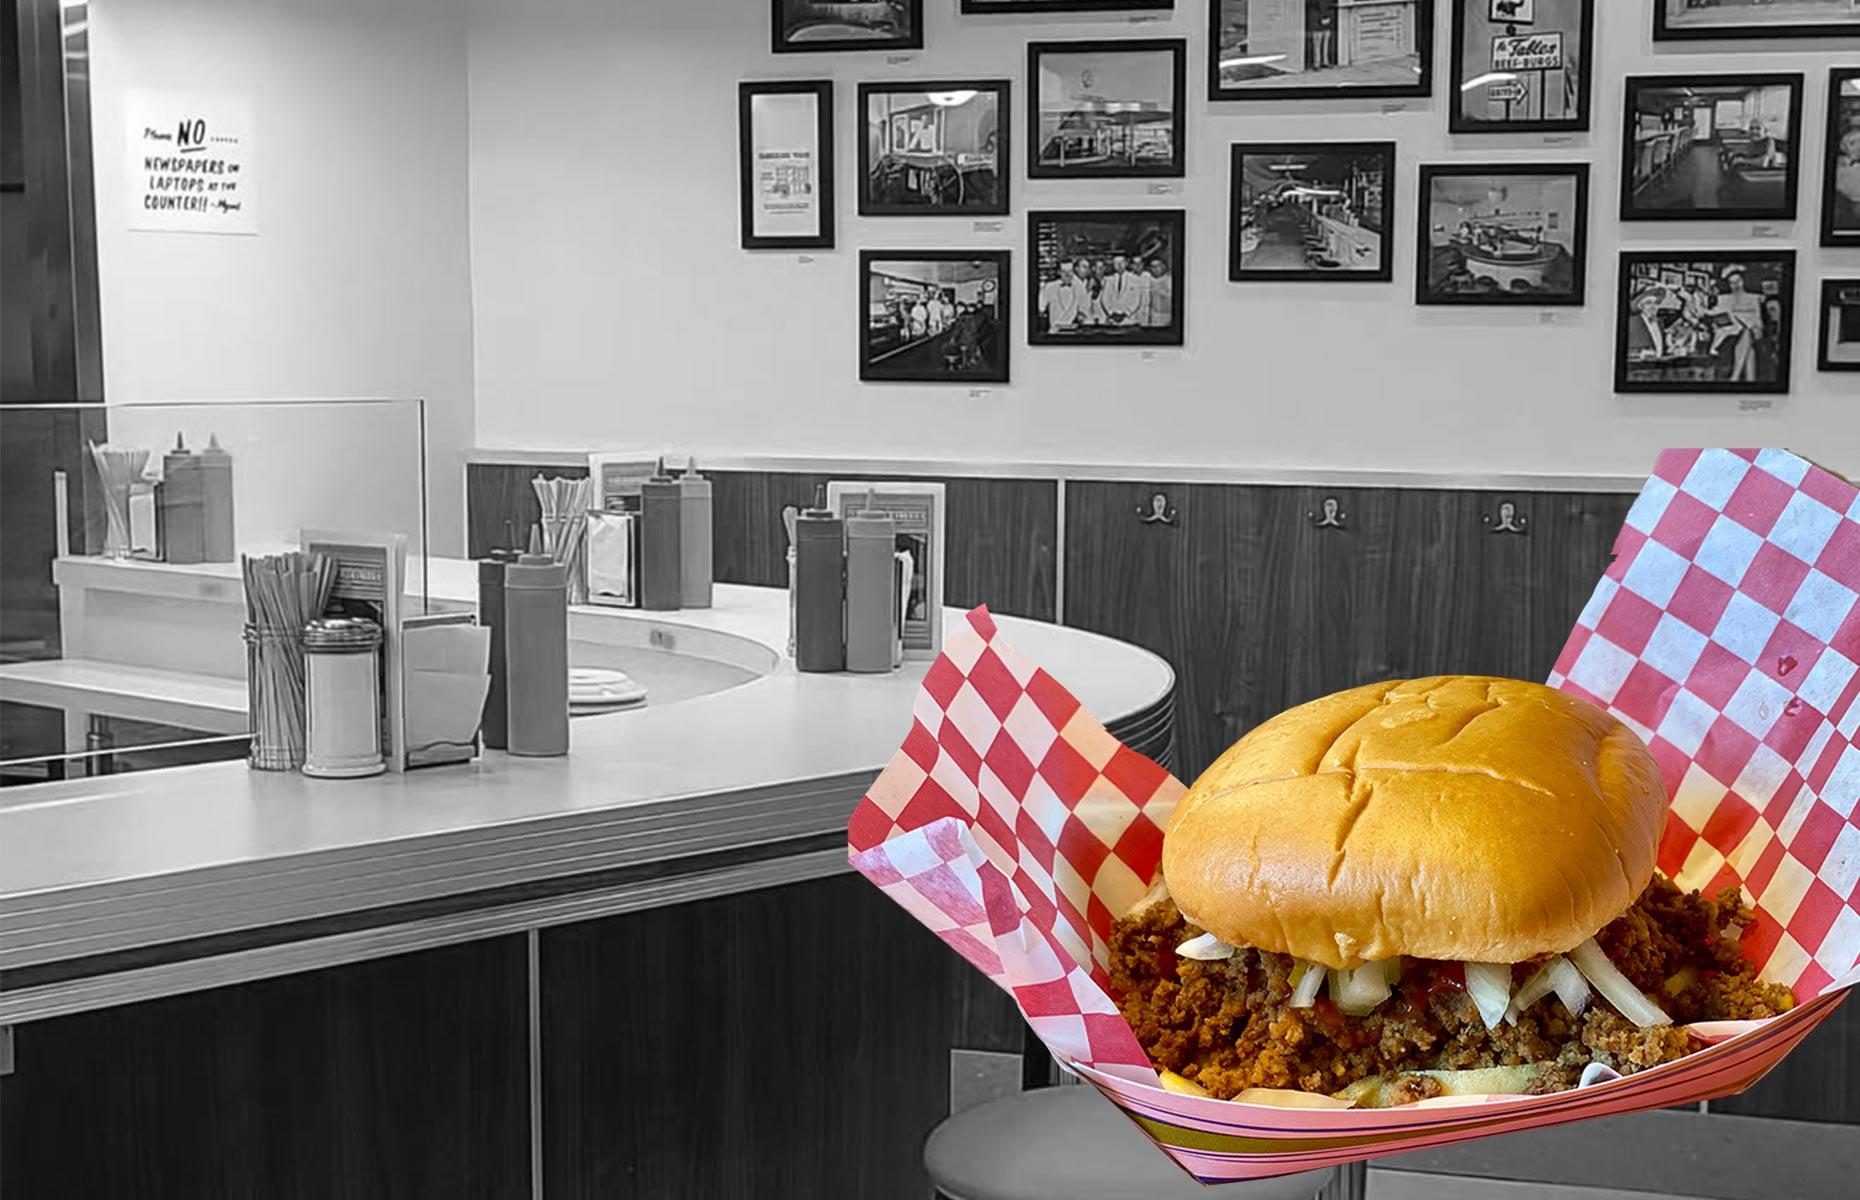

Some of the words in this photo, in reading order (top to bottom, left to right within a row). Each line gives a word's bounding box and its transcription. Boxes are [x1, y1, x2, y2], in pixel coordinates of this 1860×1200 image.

[177, 118, 206, 147] NO
[144, 156, 225, 175] NEWSPAPERS
[149, 175, 204, 193] LAPTOPS
[221, 182, 237, 191] THE
[144, 194, 208, 213] COUNTER!!
